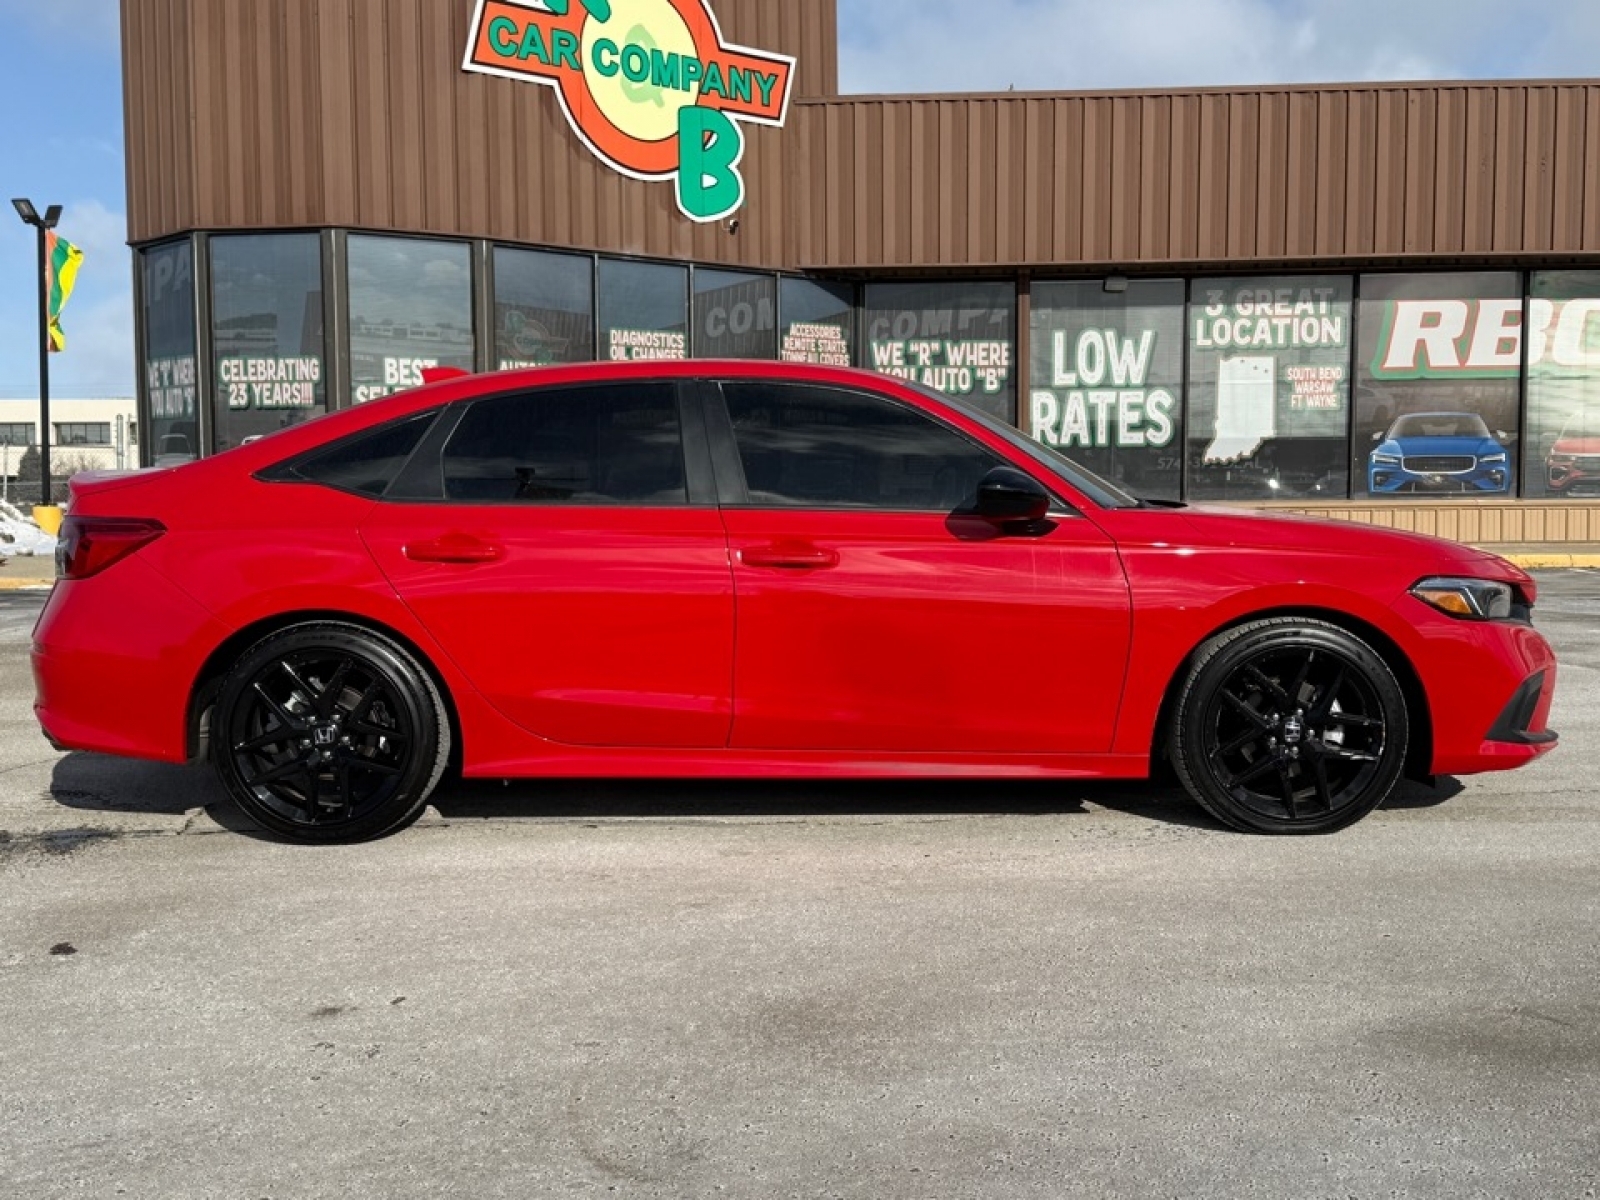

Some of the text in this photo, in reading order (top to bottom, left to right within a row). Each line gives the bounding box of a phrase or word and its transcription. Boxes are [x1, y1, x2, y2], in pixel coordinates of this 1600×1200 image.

[488, 16, 778, 107] CAR COMPANY
[677, 104, 741, 218] B
[1205, 287, 1333, 316] 3 GREAT
[610, 329, 685, 349] DIAGNOSTICS
[1196, 317, 1341, 346] LOCATION
[610, 346, 629, 361] OIL
[872, 341, 904, 366] WE
[946, 342, 1009, 366] WHERE
[1054, 330, 1153, 386] LOW
[221, 357, 320, 381] CELEBRATING
[384, 357, 438, 386] BES
[923, 367, 971, 391] AUTO
[1319, 366, 1342, 380] BEND
[229, 382, 313, 406] 23 YEARS!!!
[1291, 394, 1338, 408] FT WAYNE
[1032, 388, 1173, 445] RATES
